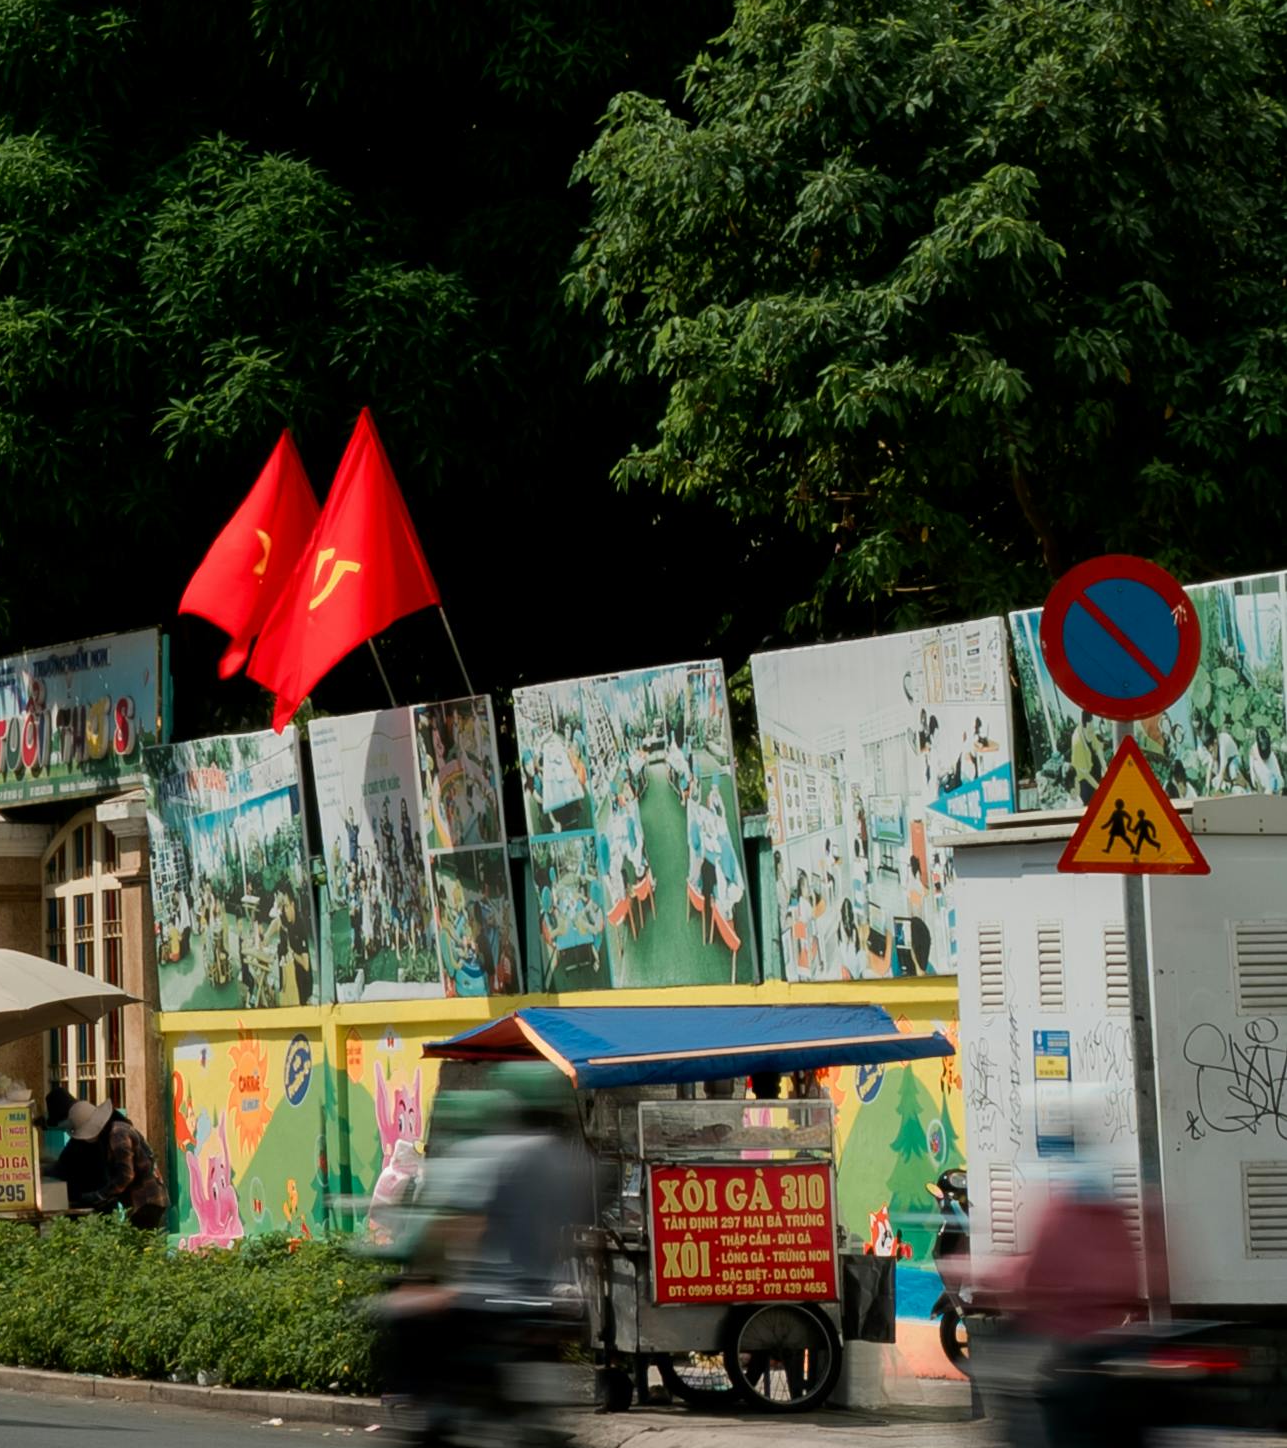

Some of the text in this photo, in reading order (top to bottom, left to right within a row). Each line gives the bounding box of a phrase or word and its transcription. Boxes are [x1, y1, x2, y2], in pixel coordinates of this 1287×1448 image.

[658, 1168, 825, 1213] XÔI GÀ 310
[662, 1212, 825, 1232] TÂN ĐỊNH 297 HAI BÀ TRƯNG
[720, 1233, 747, 1249] THẬP
[797, 1231, 811, 1244] GÀ
[662, 1232, 711, 1278] XÔI
[721, 1250, 748, 1264] LÒNG
[750, 1249, 765, 1263] GÀ
[808, 1250, 830, 1262] NON
[745, 1267, 768, 1283] BIỆT
[688, 1284, 713, 1296] 0909
[763, 1283, 781, 1295] 078
